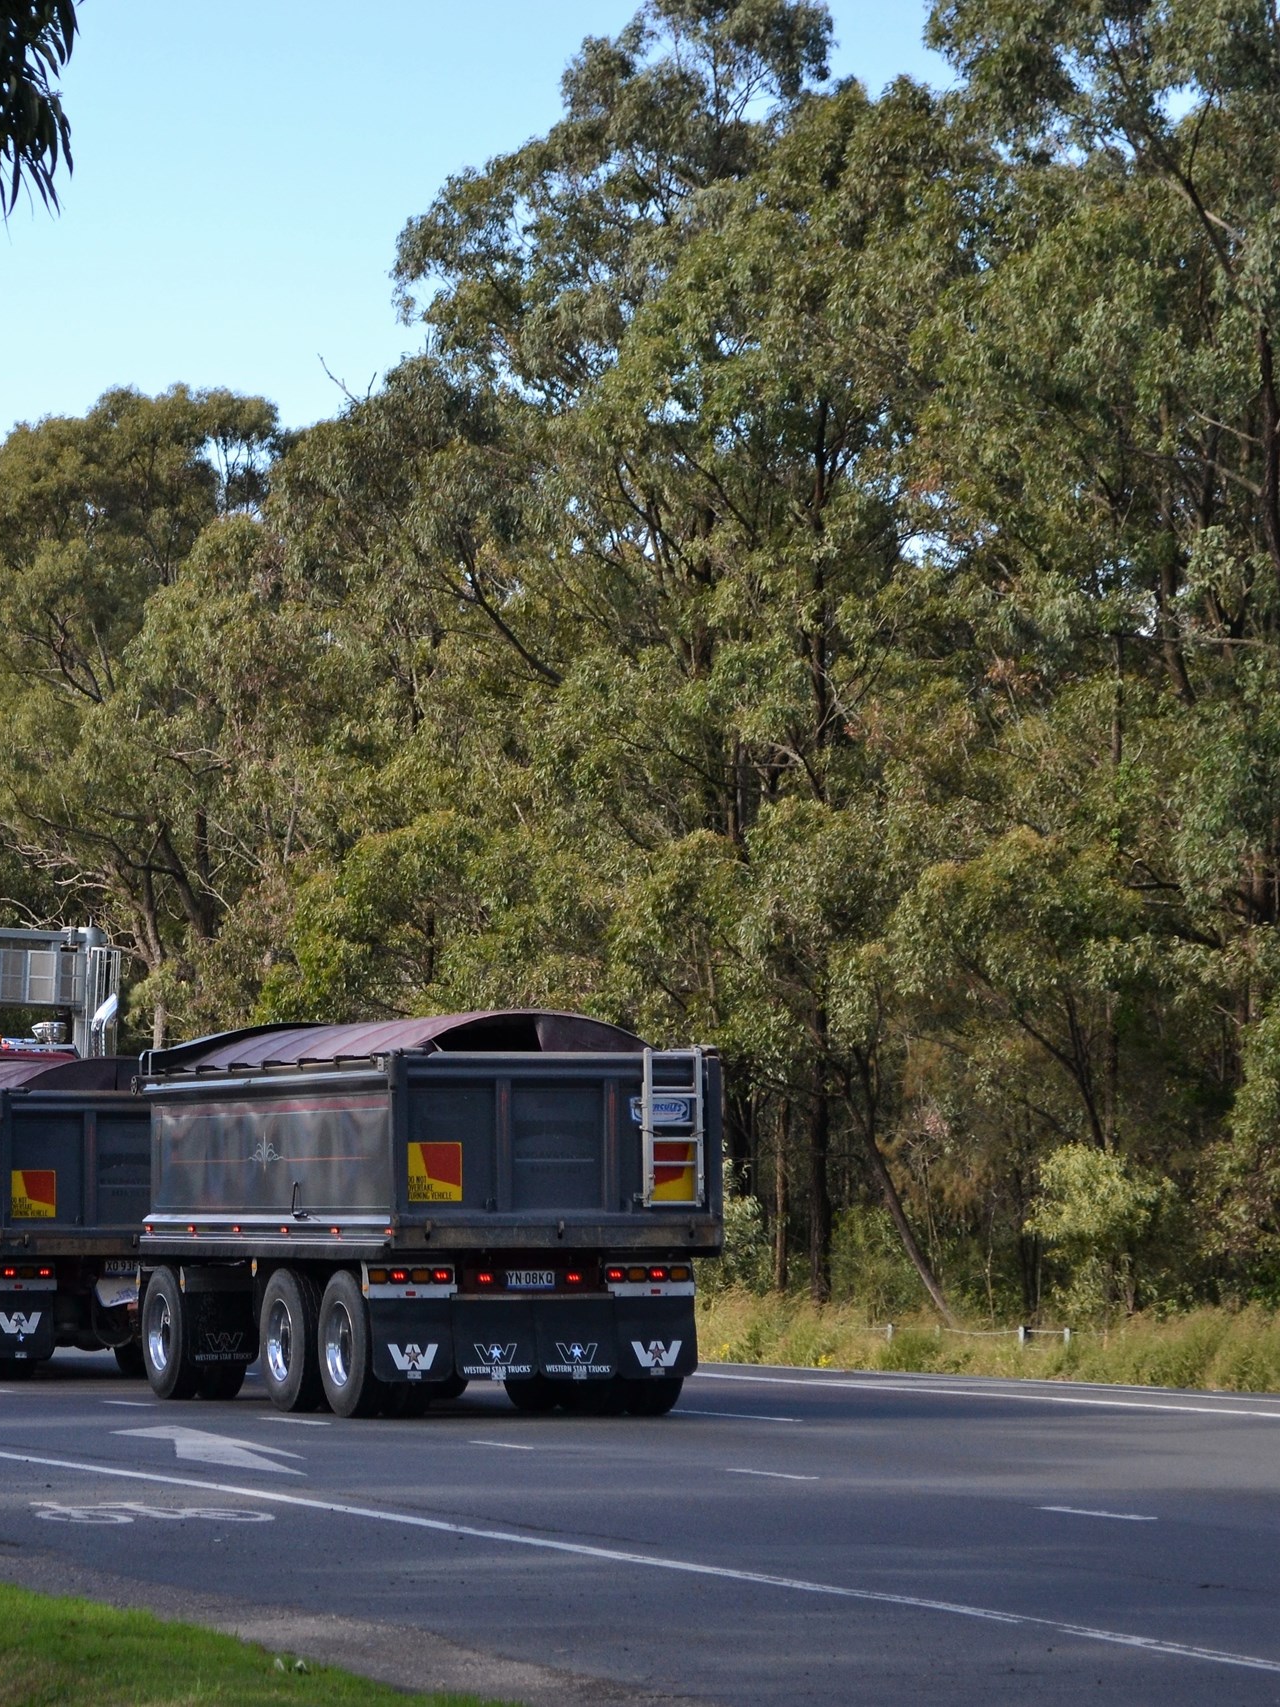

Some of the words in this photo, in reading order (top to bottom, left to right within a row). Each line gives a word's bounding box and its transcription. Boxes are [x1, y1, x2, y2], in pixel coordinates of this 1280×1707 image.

[416, 1176, 426, 1184] NOT
[431, 1192, 452, 1200] VEHICLE
[233, 1352, 253, 1360] TRUCKS
[463, 1366, 491, 1374] WESTERN
[491, 1366, 507, 1374] STAR
[508, 1365, 531, 1373] TRUCKS
[545, 1365, 571, 1373] WESTERN
[572, 1365, 588, 1373] STAR
[588, 1364, 610, 1373] TRUCKS
